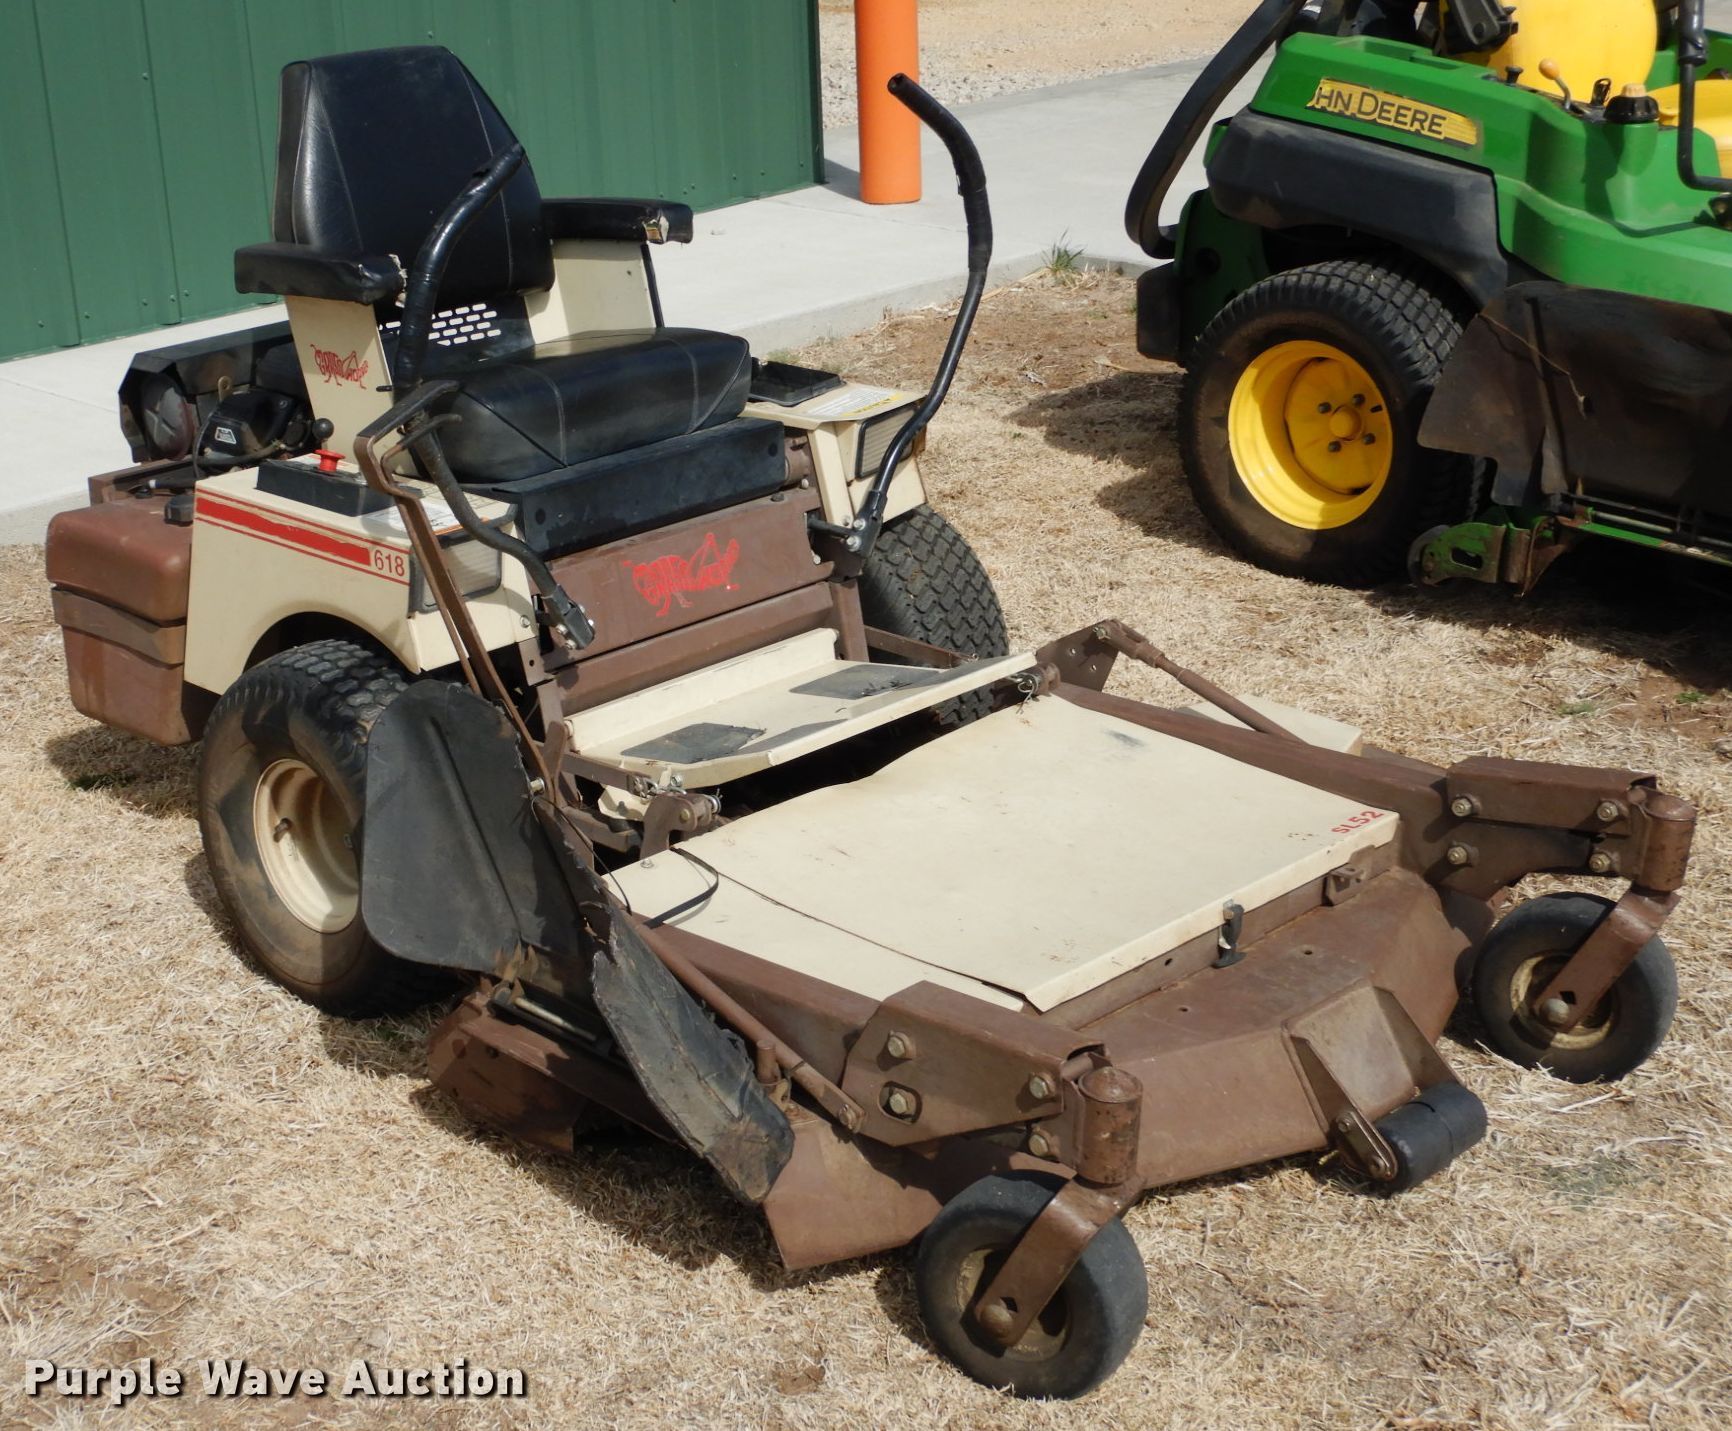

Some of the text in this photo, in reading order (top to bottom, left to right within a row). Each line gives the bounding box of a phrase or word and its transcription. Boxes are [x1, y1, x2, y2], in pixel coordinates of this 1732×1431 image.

[1357, 91, 1447, 135] DEERE
[374, 549, 405, 577] 618
[1331, 811, 1385, 833] SL52
